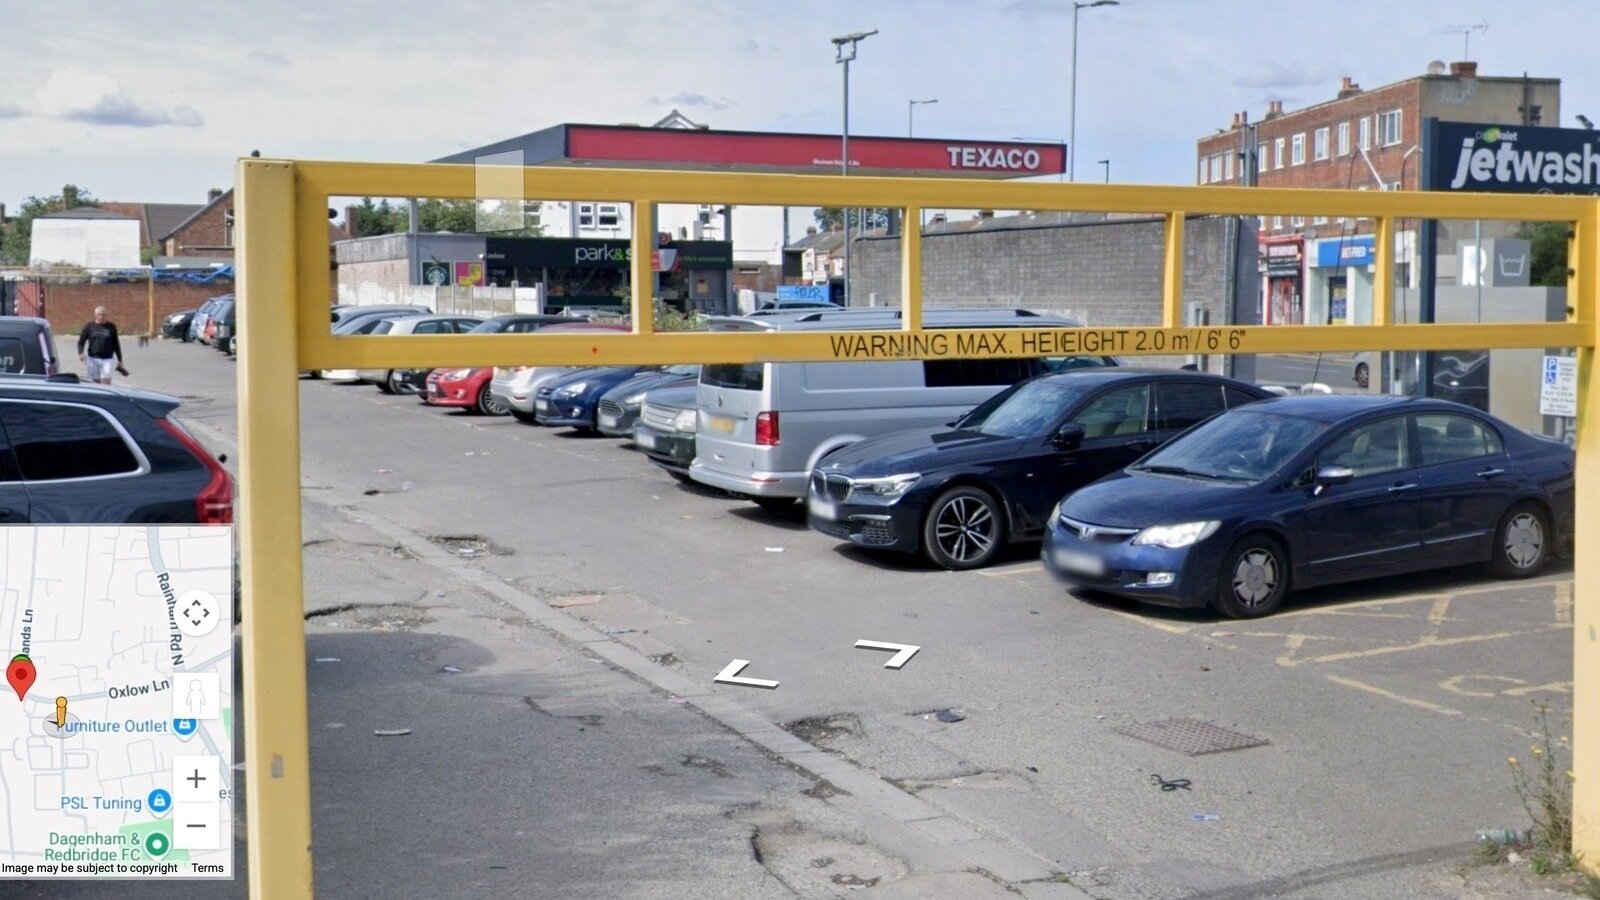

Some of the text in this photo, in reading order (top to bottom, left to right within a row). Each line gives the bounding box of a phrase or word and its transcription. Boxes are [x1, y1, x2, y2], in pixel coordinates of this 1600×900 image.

[946, 146, 1040, 169] TEXACO
[1451, 138, 1600, 189] jetwash
[830, 334, 948, 357] WARNING
[957, 333, 1012, 354] MAX.
[1135, 330, 1165, 351] 2.0
